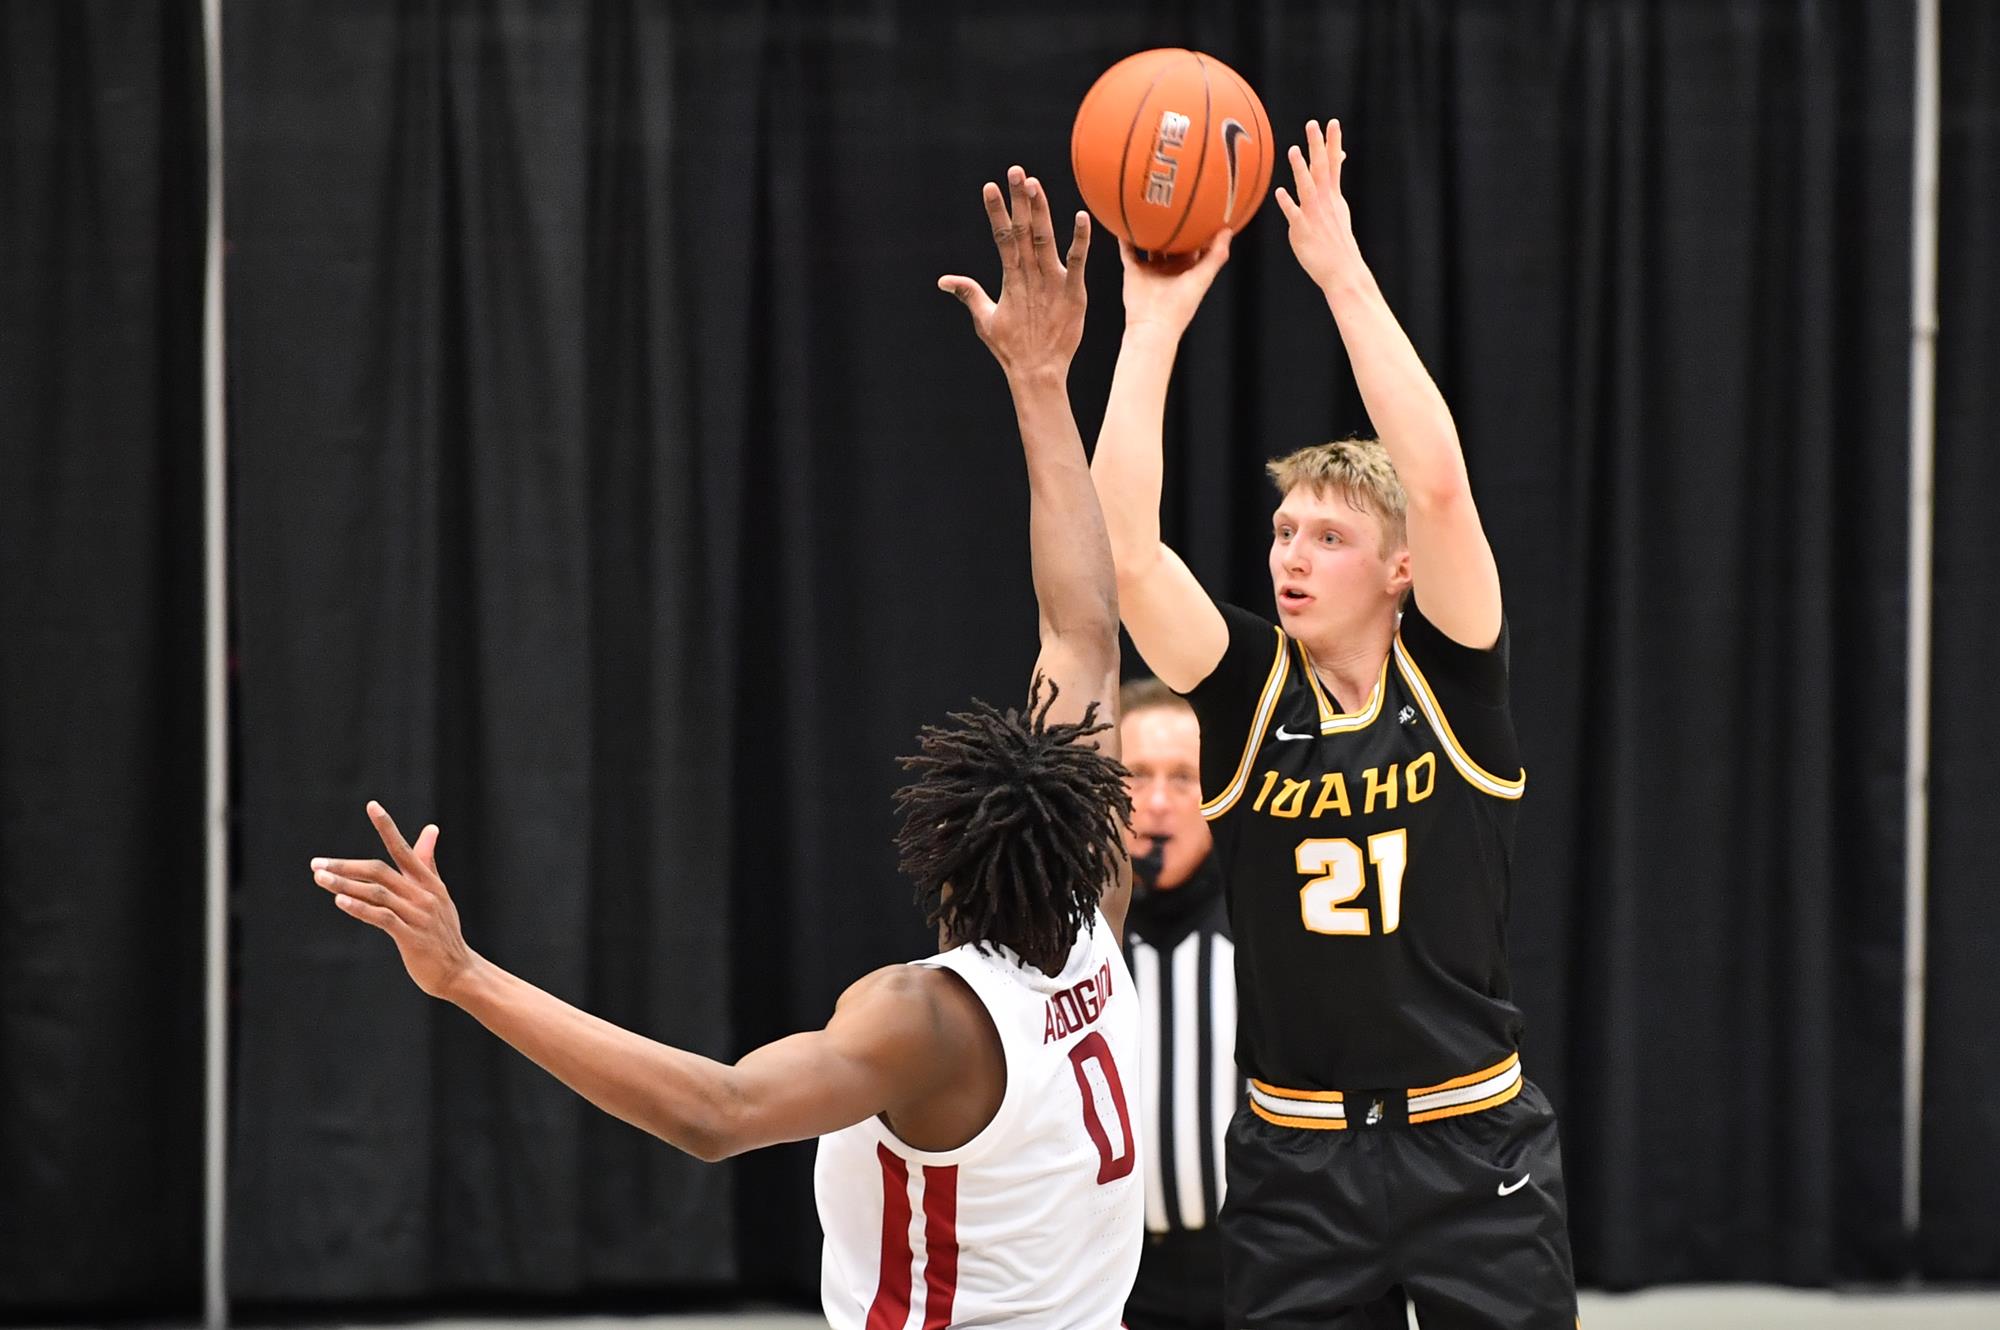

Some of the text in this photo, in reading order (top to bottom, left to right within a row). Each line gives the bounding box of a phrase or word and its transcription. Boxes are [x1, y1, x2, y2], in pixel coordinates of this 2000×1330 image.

[1146, 111, 1190, 208] ELITE
[1252, 752, 1436, 818] IDAHO
[1294, 828, 1407, 936] 21
[1068, 1031, 1135, 1185] 0
